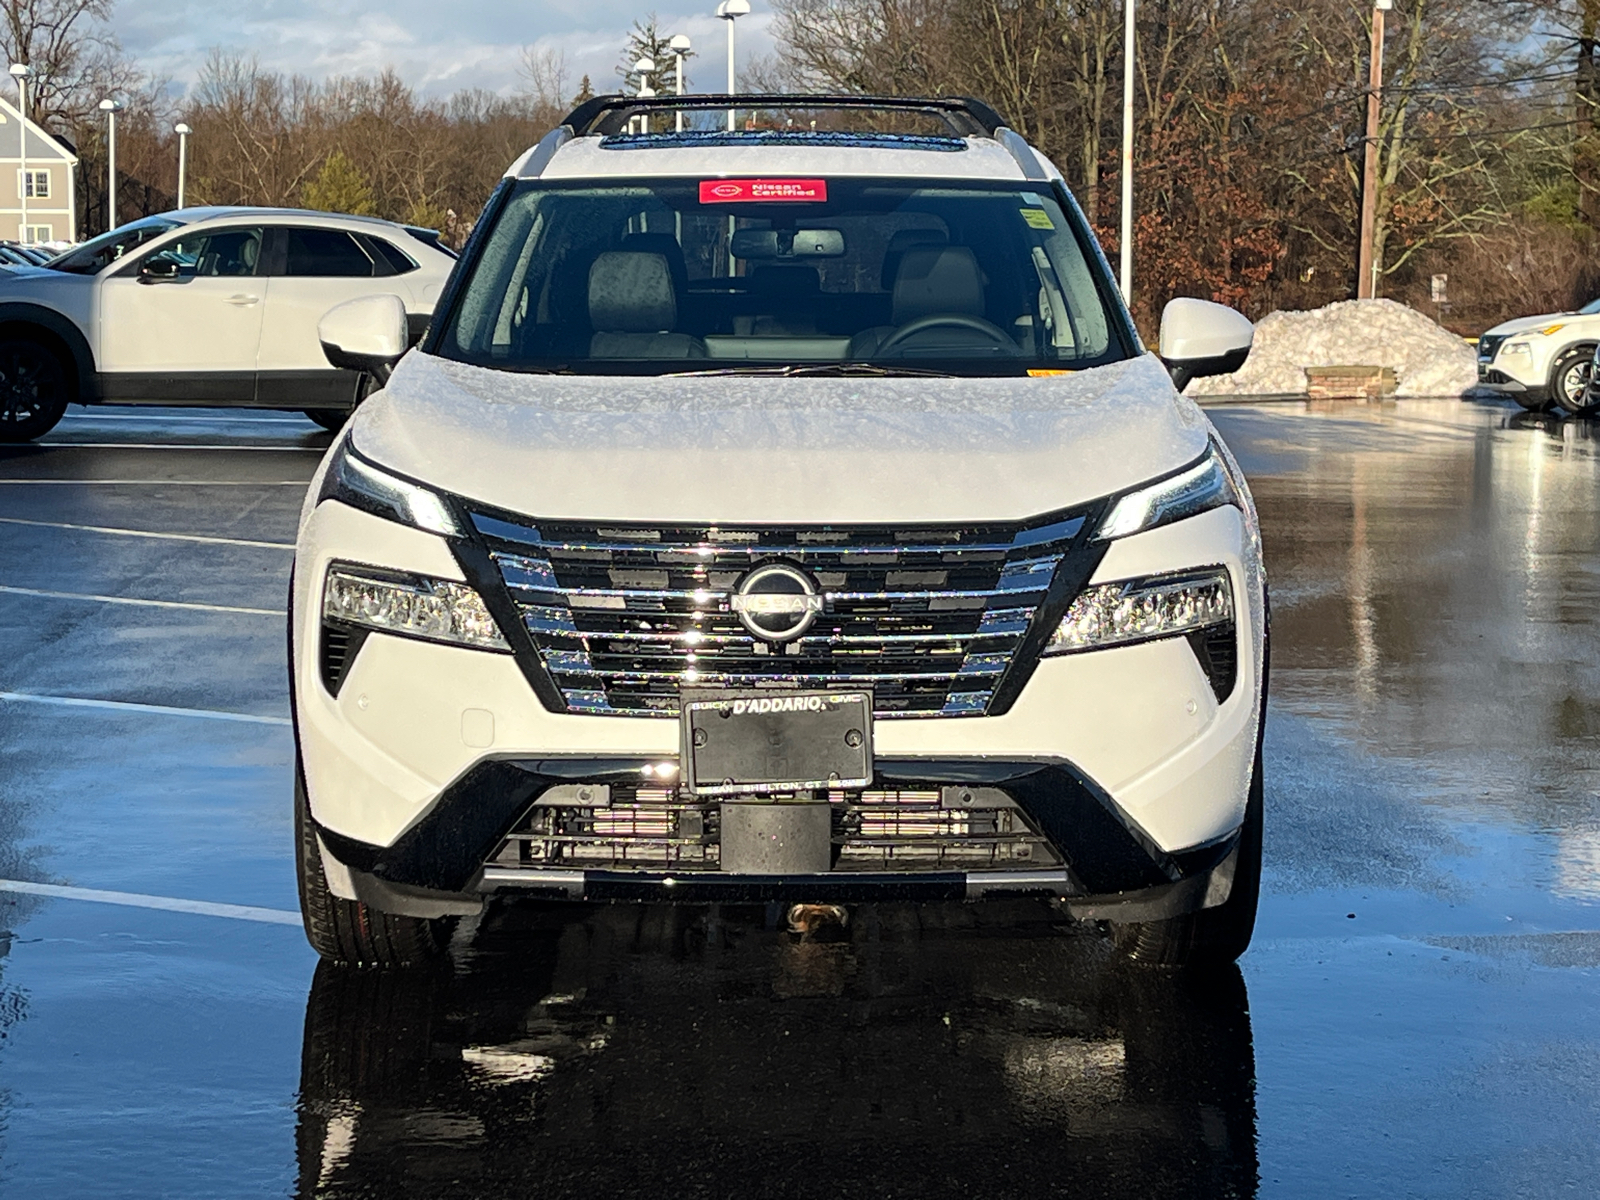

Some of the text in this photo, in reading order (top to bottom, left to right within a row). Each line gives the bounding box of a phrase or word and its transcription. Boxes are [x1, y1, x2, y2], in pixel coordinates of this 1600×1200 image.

[733, 597, 822, 610] NSSAN
[692, 701, 728, 711] BUICK
[830, 694, 861, 703] GMC
[805, 780, 822, 788] CT
